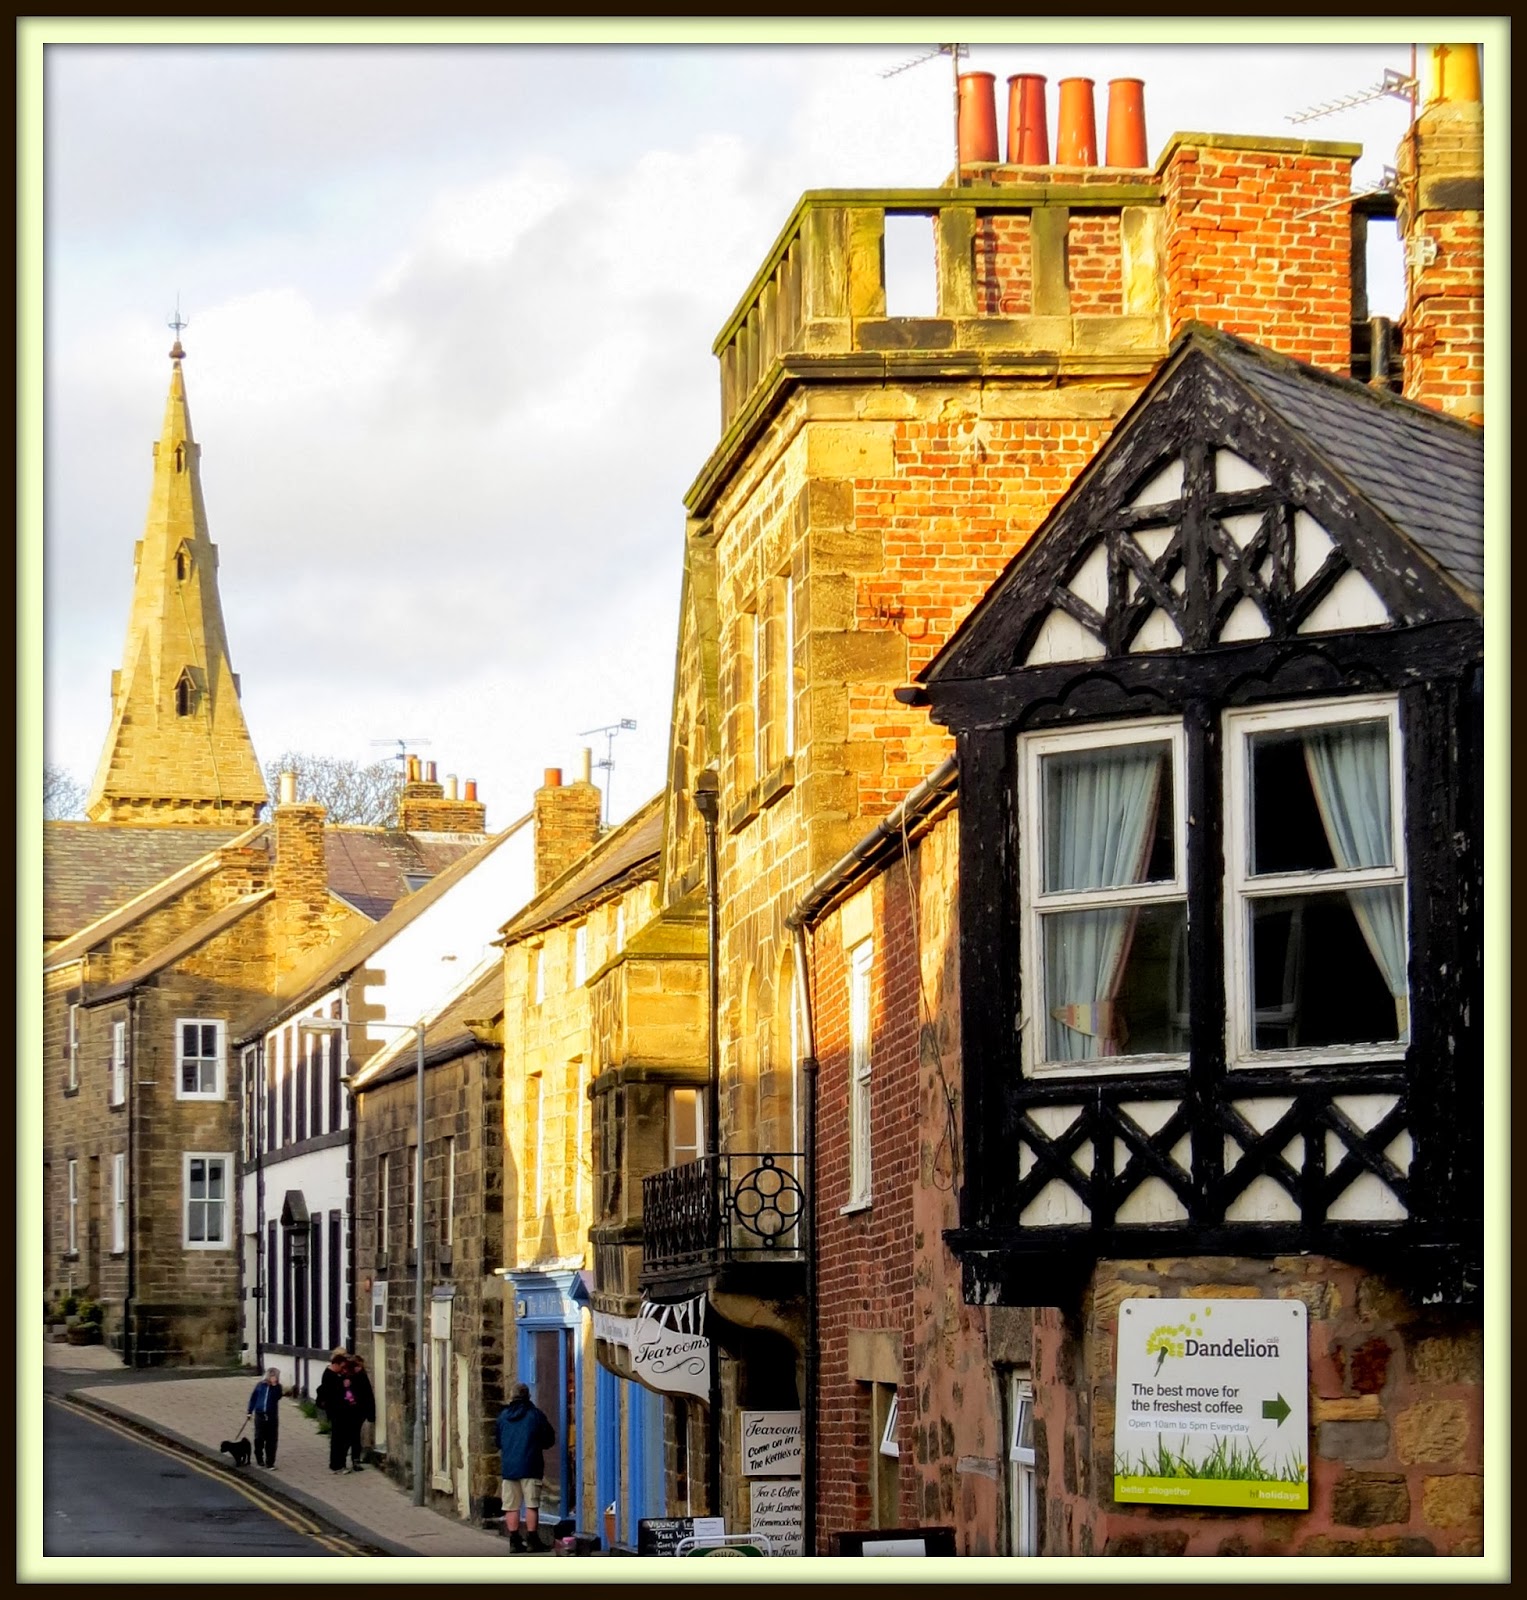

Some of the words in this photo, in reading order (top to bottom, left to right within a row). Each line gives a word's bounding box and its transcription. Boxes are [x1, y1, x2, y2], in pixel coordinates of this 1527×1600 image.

[635, 1337, 710, 1363] Tearooms
[1185, 1338, 1279, 1358] Dandelion
[1131, 1383, 1154, 1396] The
[1157, 1384, 1183, 1397] best
[1186, 1387, 1219, 1398] move
[1222, 1385, 1239, 1398] for
[1131, 1399, 1150, 1412] the
[1153, 1400, 1202, 1413] freshest
[1205, 1400, 1243, 1414] coffee
[1128, 1419, 1151, 1431] Open
[1153, 1420, 1177, 1430] 10am
[1179, 1420, 1187, 1430] to
[1189, 1421, 1208, 1433] 5pm
[1210, 1422, 1250, 1433] Everyday
[748, 1443, 770, 1458] Come
[772, 1439, 782, 1448] on
[784, 1436, 794, 1445] in
[750, 1460, 763, 1470] The
[754, 1485, 769, 1498] Tea
[778, 1486, 800, 1499] Coffee
[1120, 1484, 1146, 1495] better
[1148, 1486, 1191, 1497] altogether
[754, 1502, 775, 1514] Light
